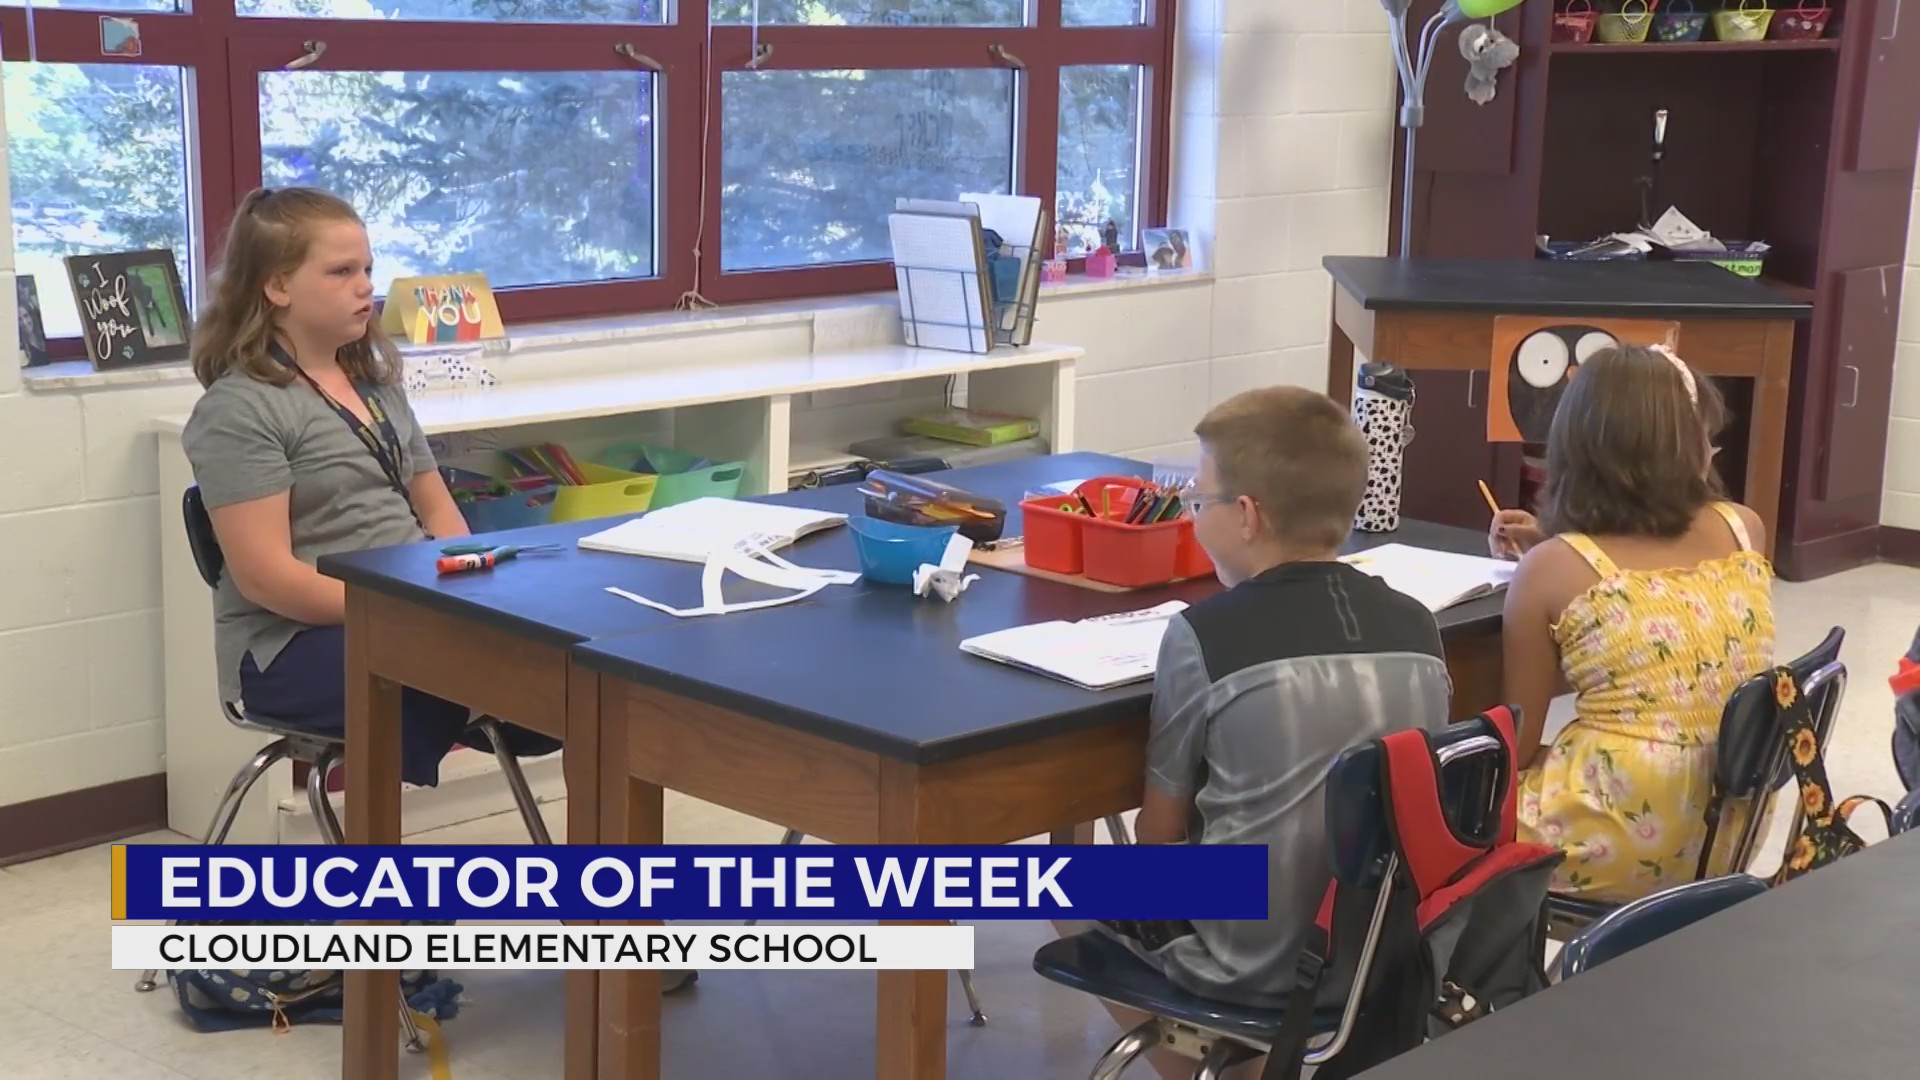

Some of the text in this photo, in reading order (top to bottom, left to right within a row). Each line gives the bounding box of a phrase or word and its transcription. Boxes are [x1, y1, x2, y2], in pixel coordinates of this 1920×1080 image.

[92, 262, 108, 288] I
[83, 274, 130, 317] Woof
[414, 285, 477, 308] THANK
[420, 302, 481, 327] YOU
[97, 318, 138, 360] you
